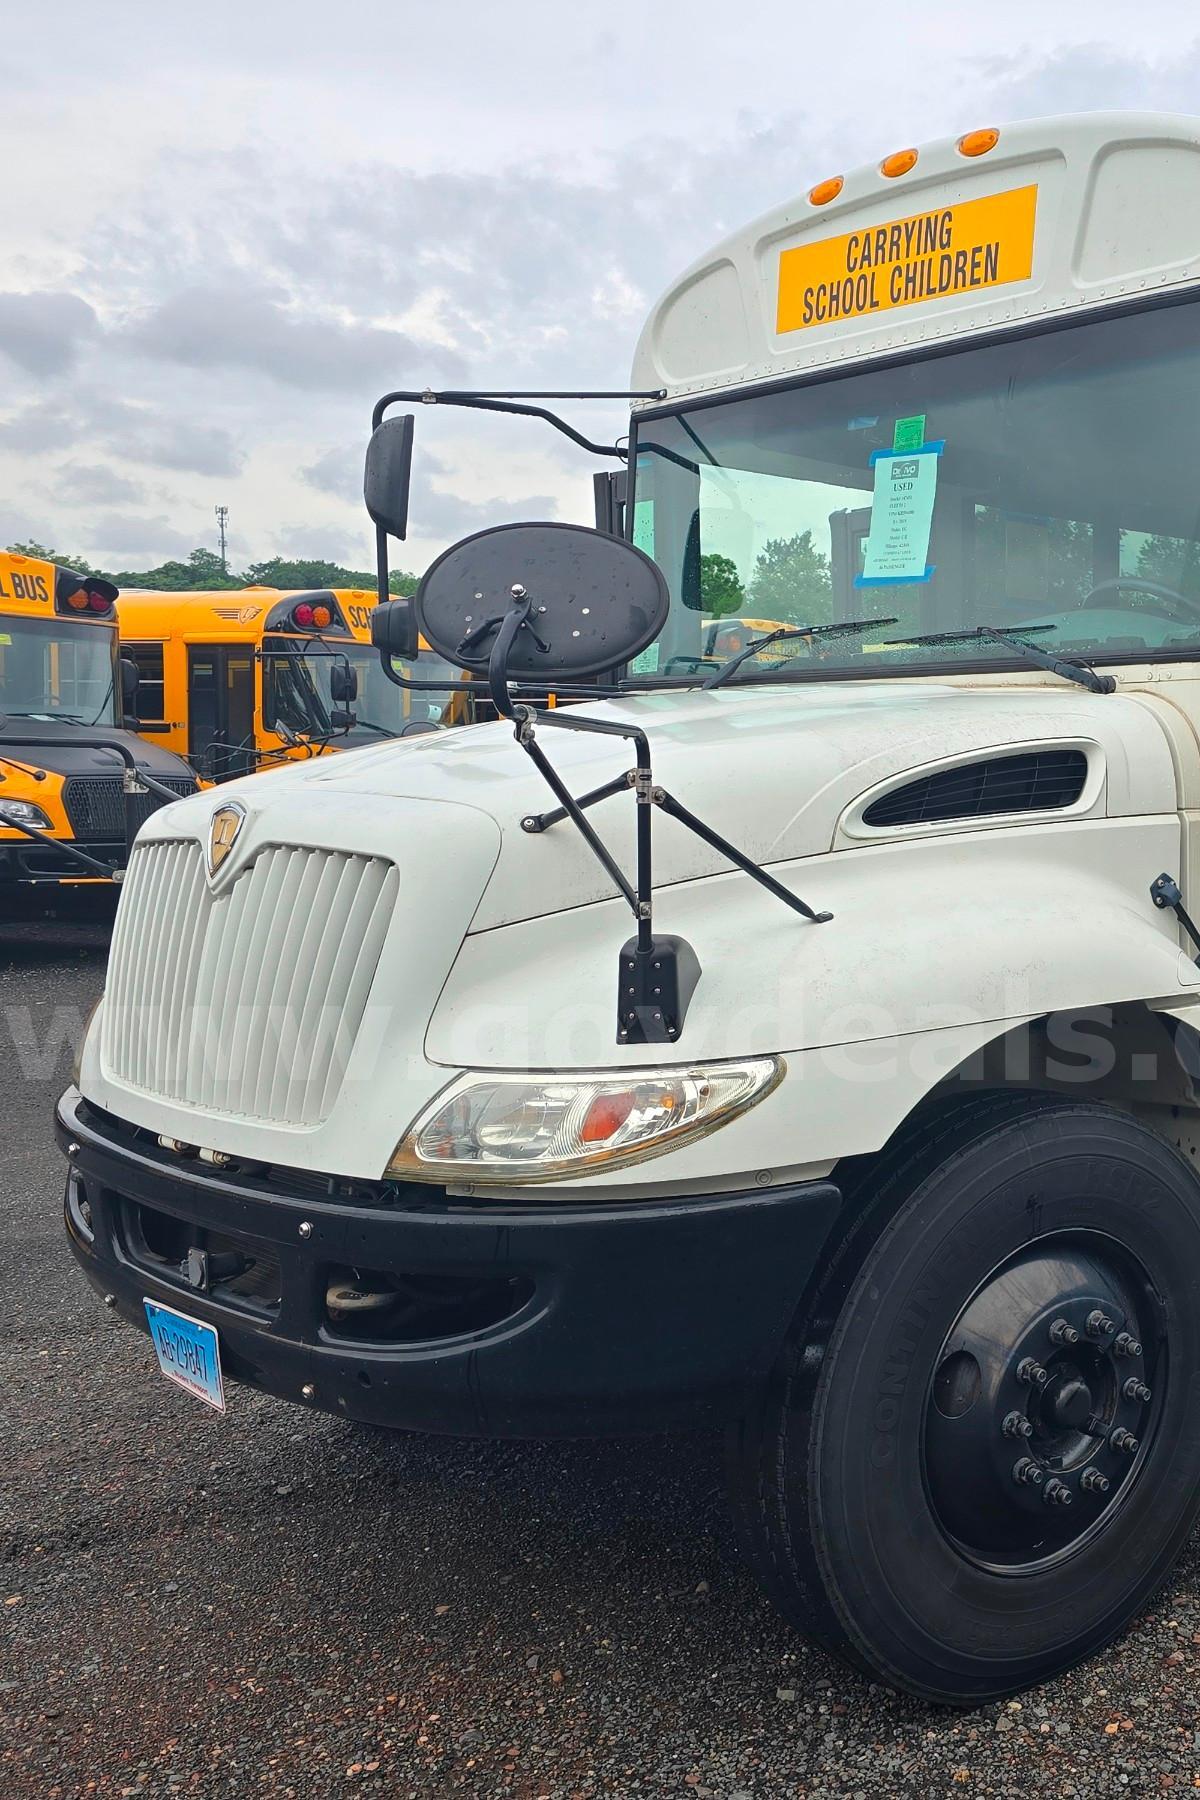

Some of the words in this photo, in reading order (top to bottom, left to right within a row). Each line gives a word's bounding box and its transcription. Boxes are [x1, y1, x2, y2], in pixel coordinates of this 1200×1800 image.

[846, 210, 953, 273] CARRYING
[802, 271, 880, 325] SCHOOL
[889, 242, 1001, 304] CHILDREN
[893, 482, 913, 492] USED
[10, 572, 49, 603] BUS
